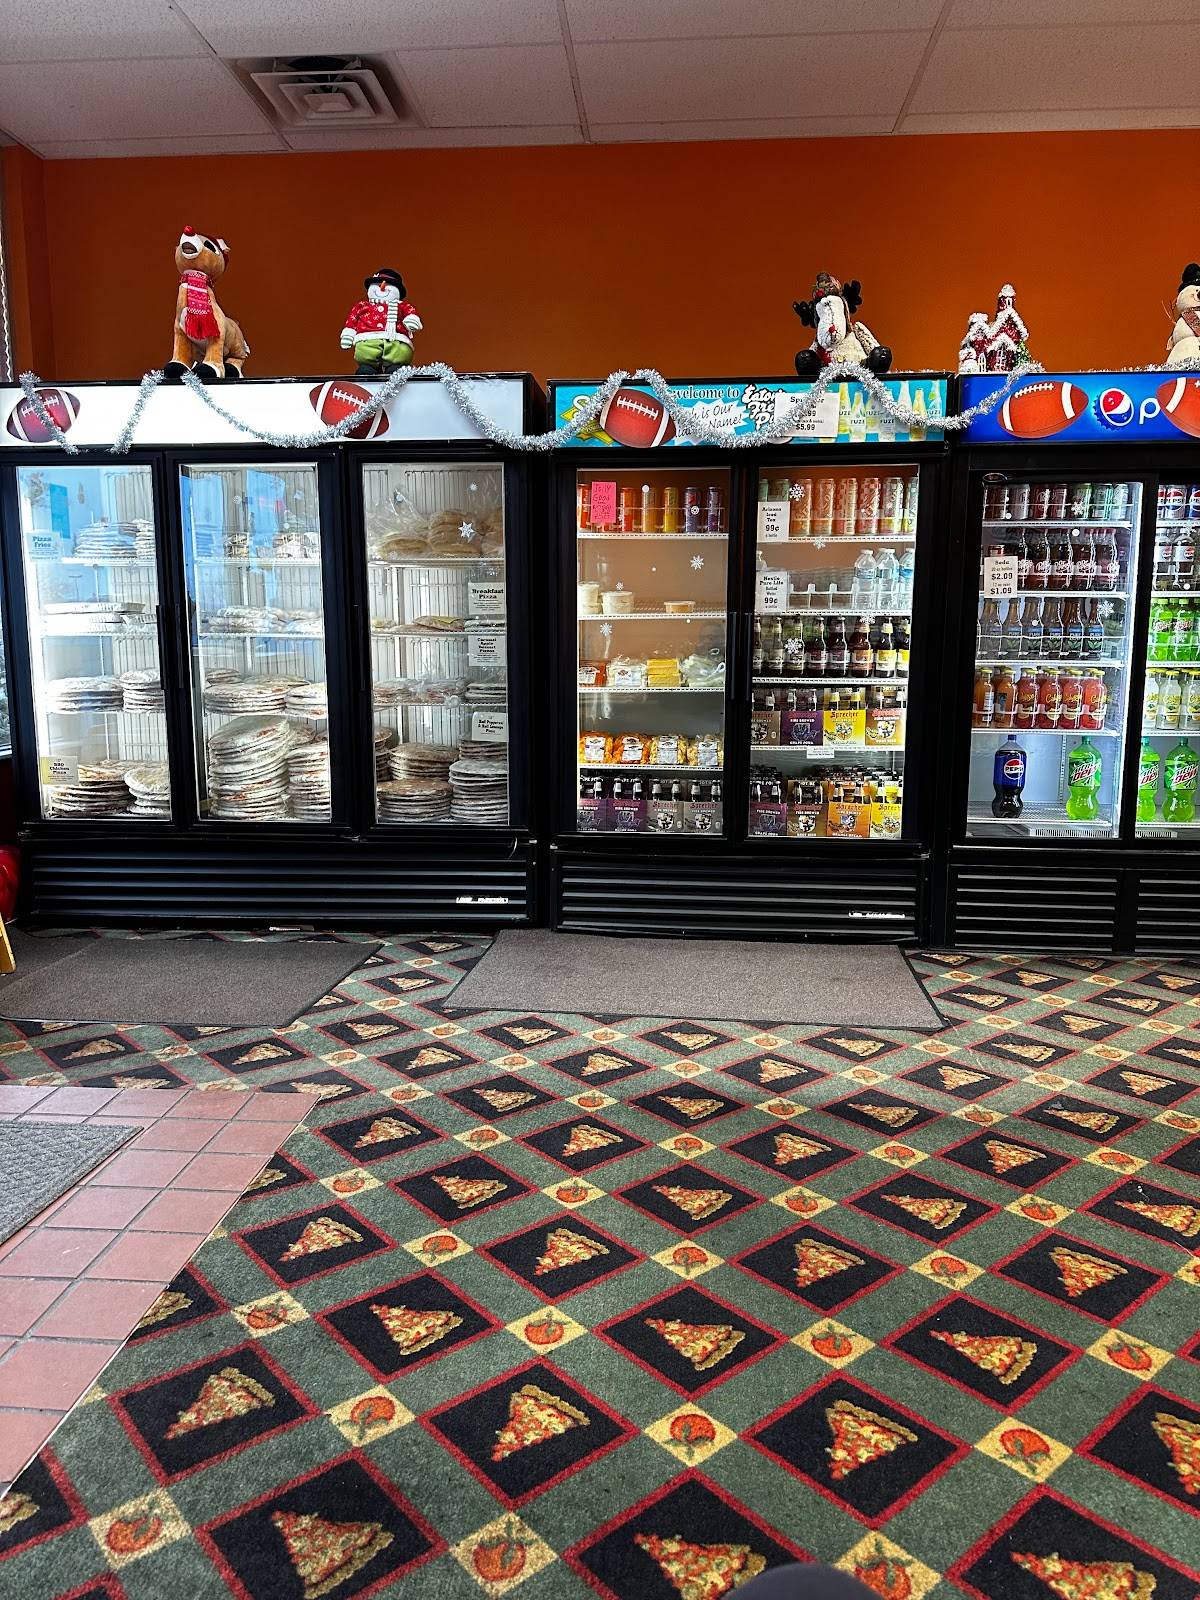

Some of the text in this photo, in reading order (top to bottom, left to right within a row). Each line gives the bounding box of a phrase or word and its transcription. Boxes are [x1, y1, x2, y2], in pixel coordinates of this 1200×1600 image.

[727, 387, 740, 399] to
[701, 405, 710, 419] is
[713, 403, 733, 416] Our
[708, 413, 743, 430] Name!
[991, 572, 1013, 580] $2.09
